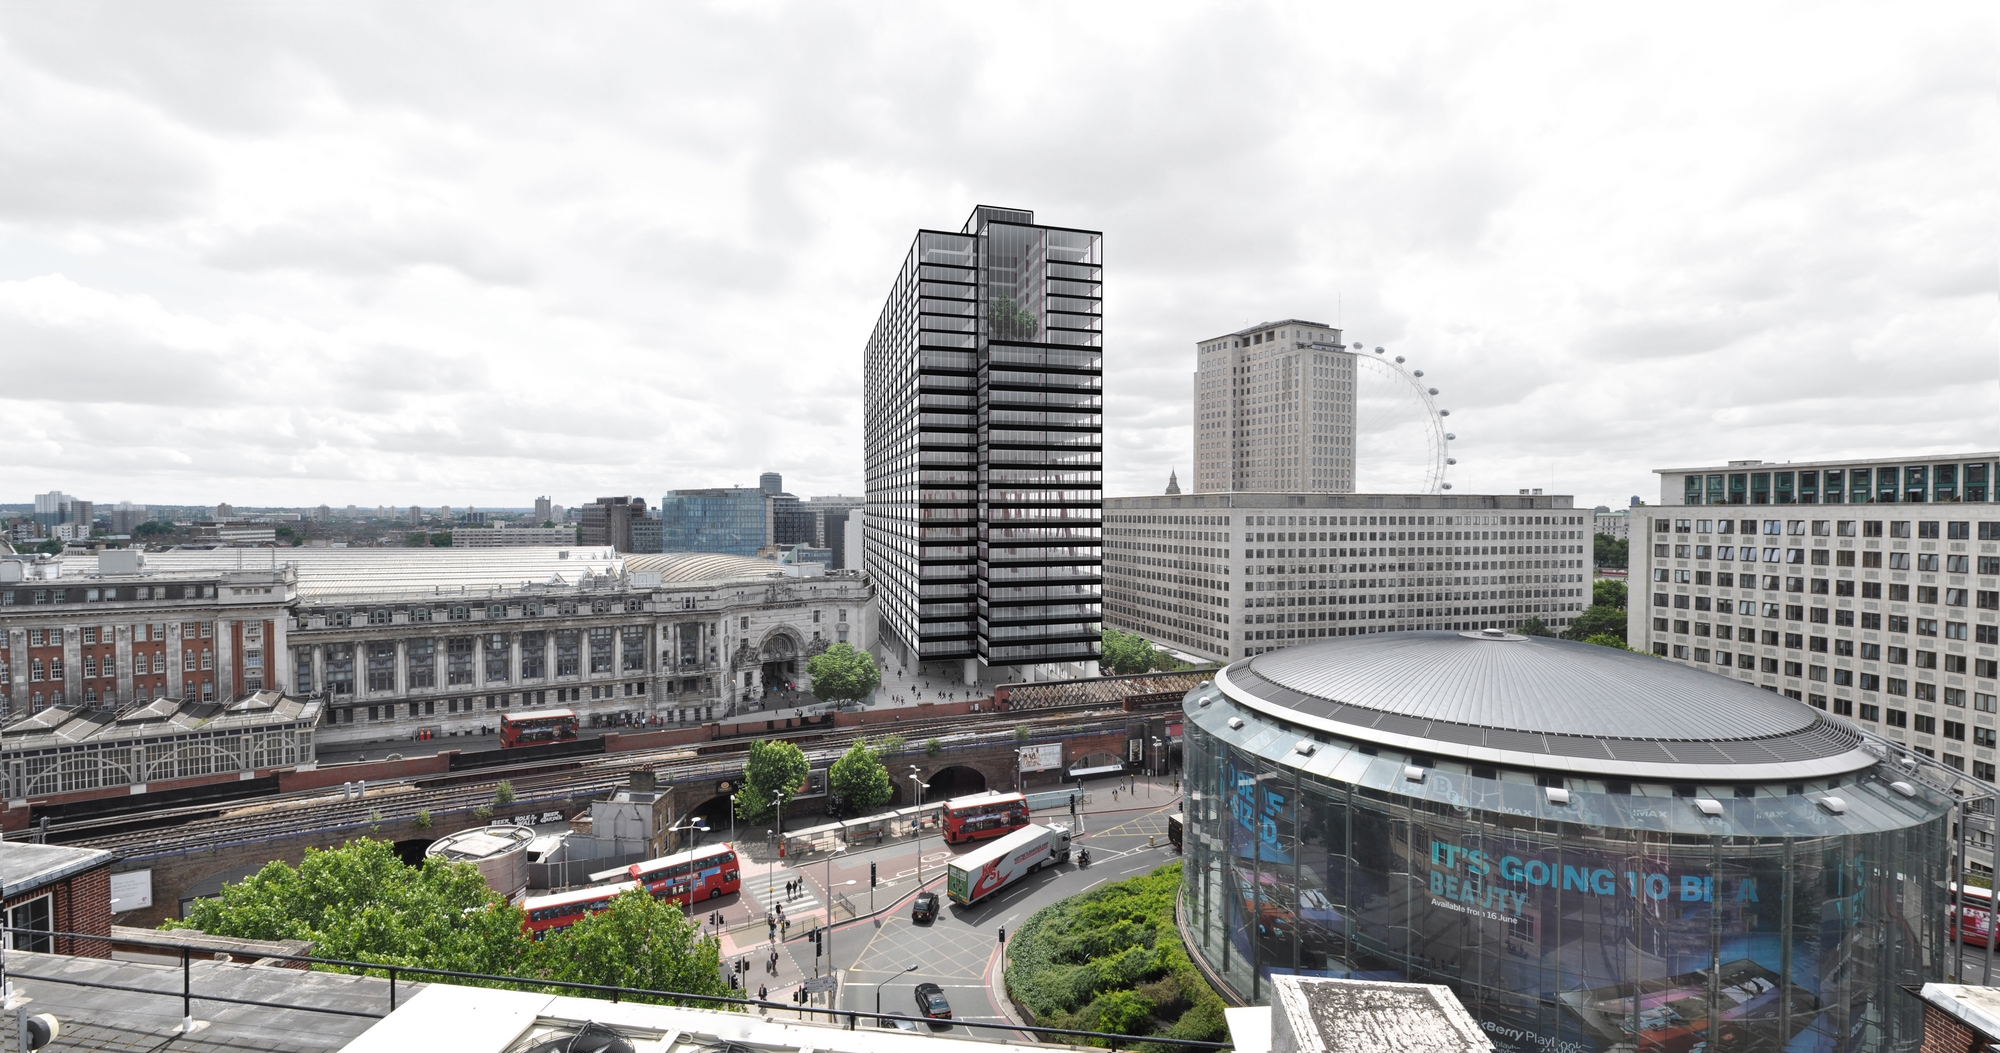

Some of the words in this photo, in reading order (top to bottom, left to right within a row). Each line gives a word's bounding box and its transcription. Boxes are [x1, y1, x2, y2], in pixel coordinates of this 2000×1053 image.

[1497, 806, 1533, 818] IMAX
[982, 863, 1003, 883] KSL
[1500, 855, 1615, 896] GOING
[1624, 872, 1670, 900] TO
[1735, 878, 1759, 902] A
[1430, 870, 1526, 916] BEAUTY
[1431, 898, 1466, 913] Available
[1487, 911, 1497, 920] 16
[1498, 914, 1518, 924] June
[1478, 1019, 1524, 1041] kBerry
